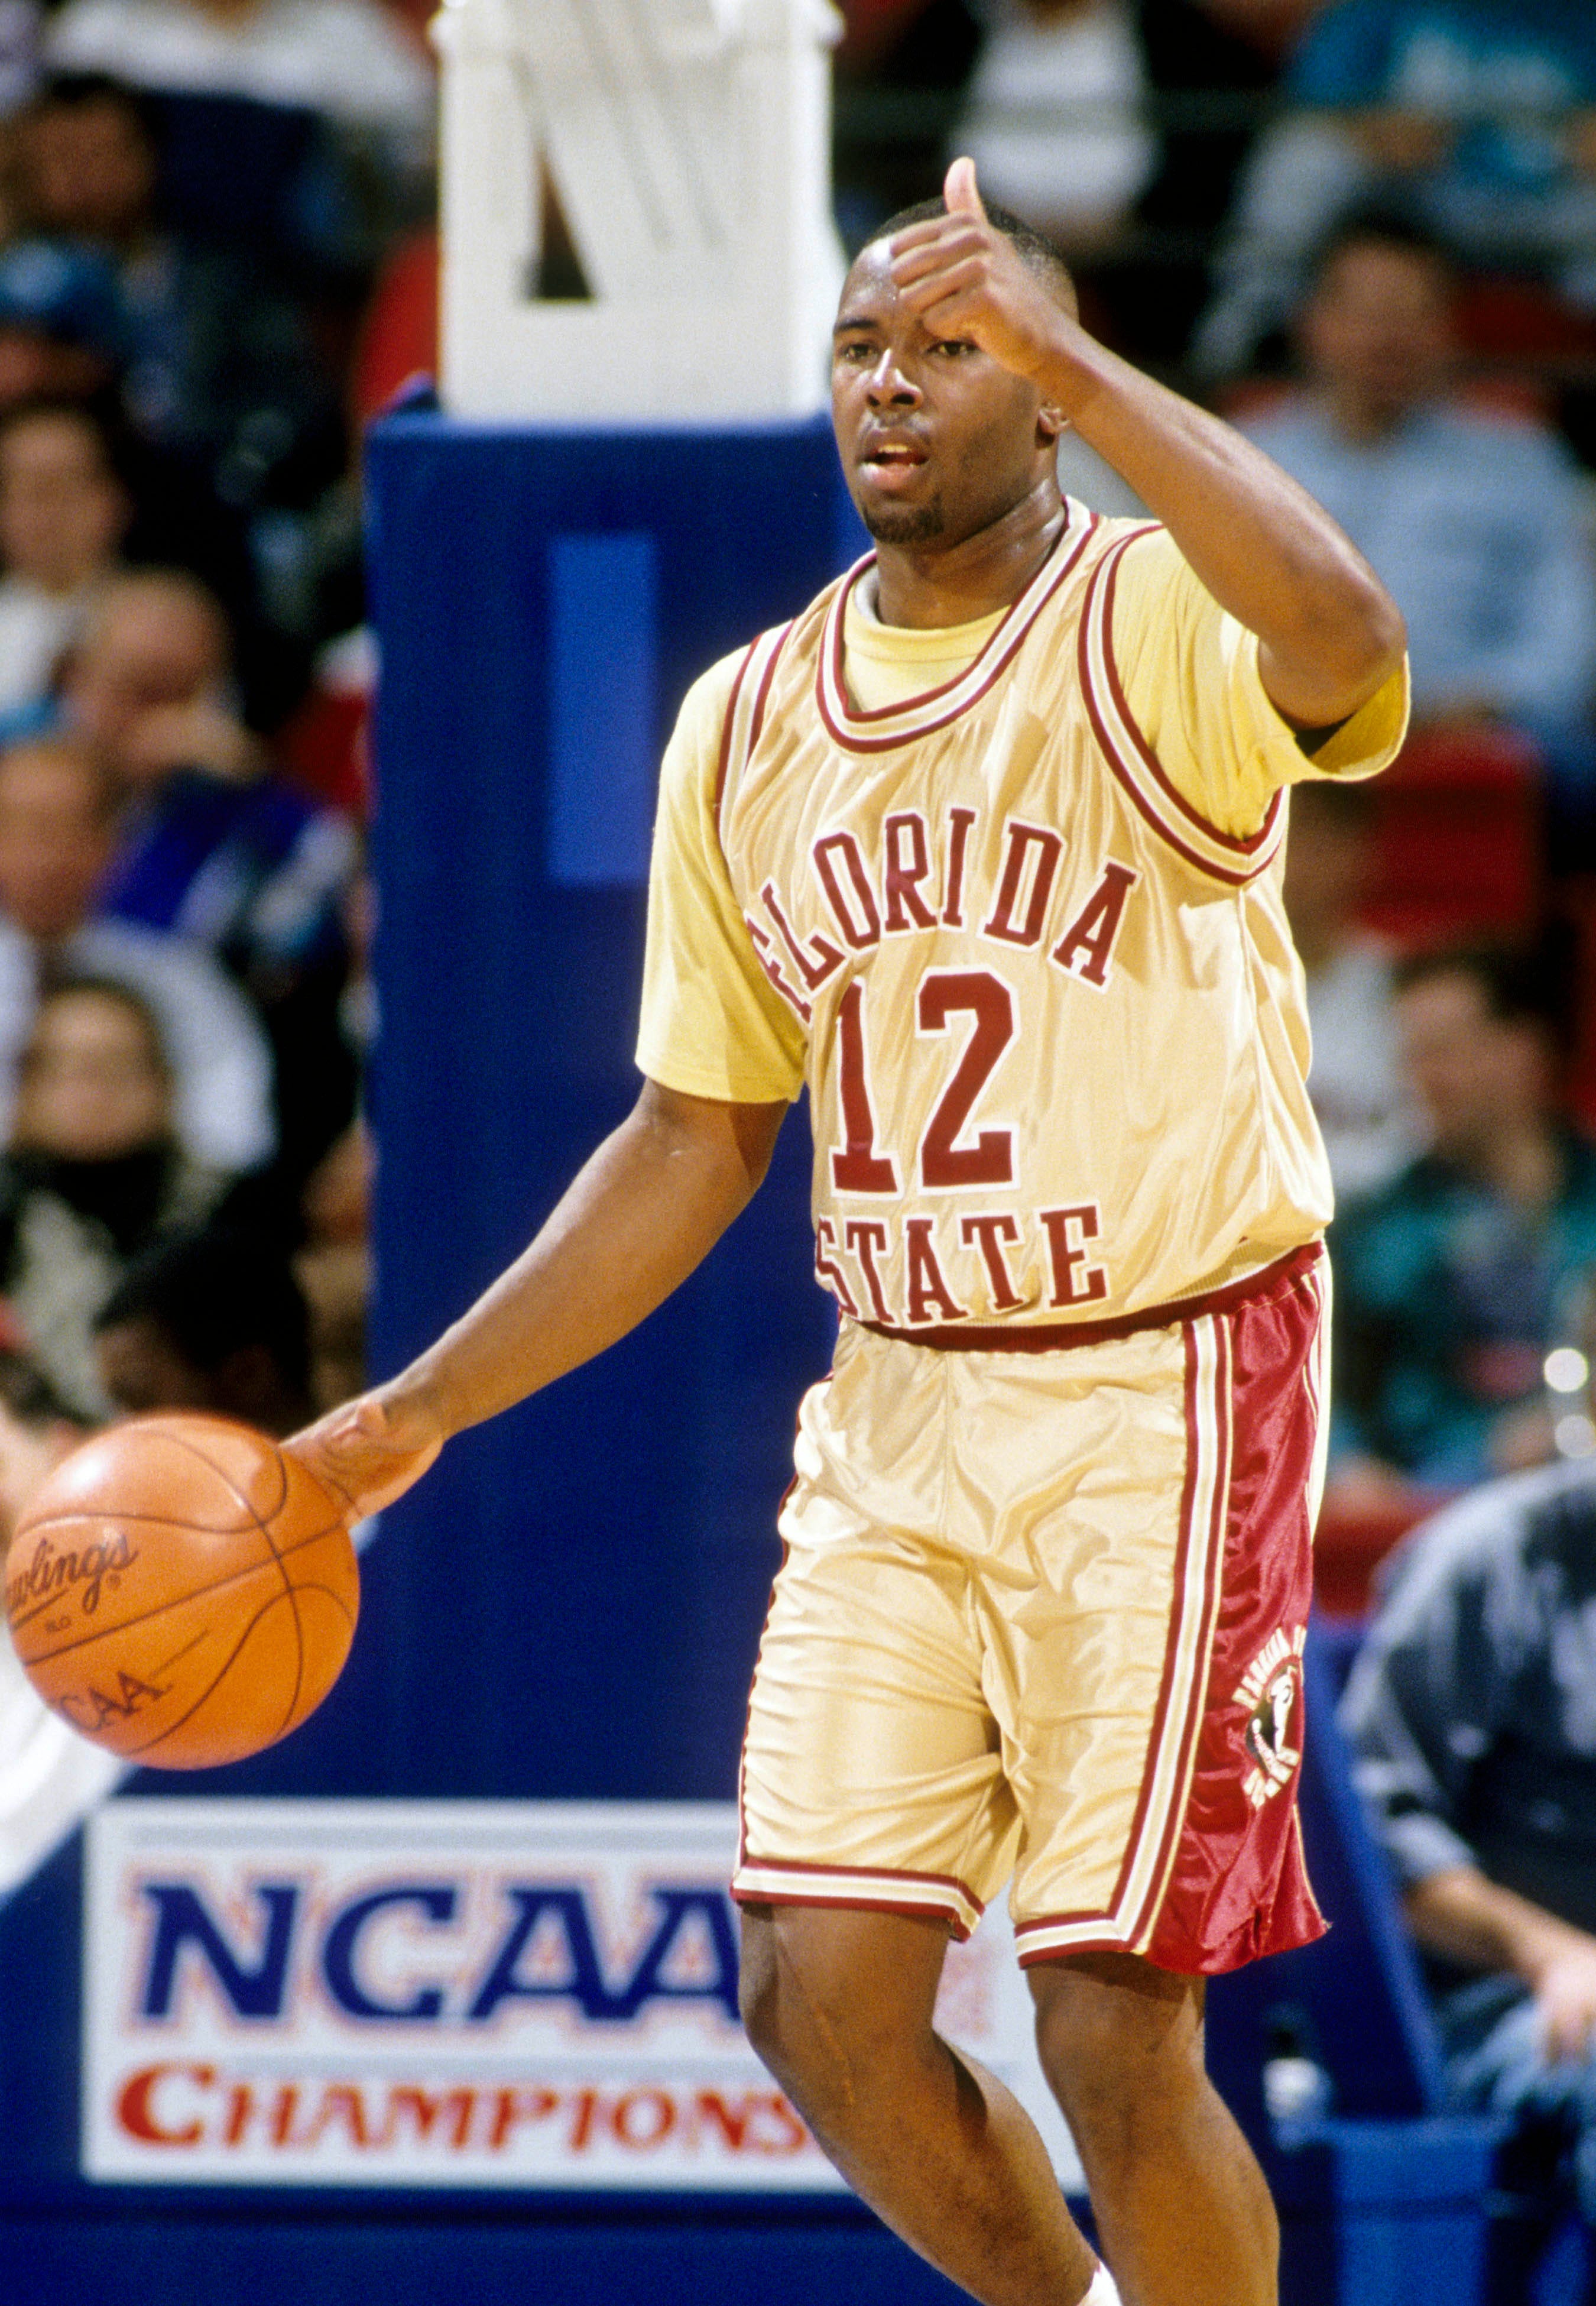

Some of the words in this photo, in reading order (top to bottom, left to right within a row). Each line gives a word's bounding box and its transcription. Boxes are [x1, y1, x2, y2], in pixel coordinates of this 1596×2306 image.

[745, 807, 1139, 1026] FLORIDA
[829, 967, 1018, 1196] 12
[814, 1203, 1110, 1326] STATE
[50, 1670, 174, 1732] CAA
[140, 1885, 741, 2020] NCAA
